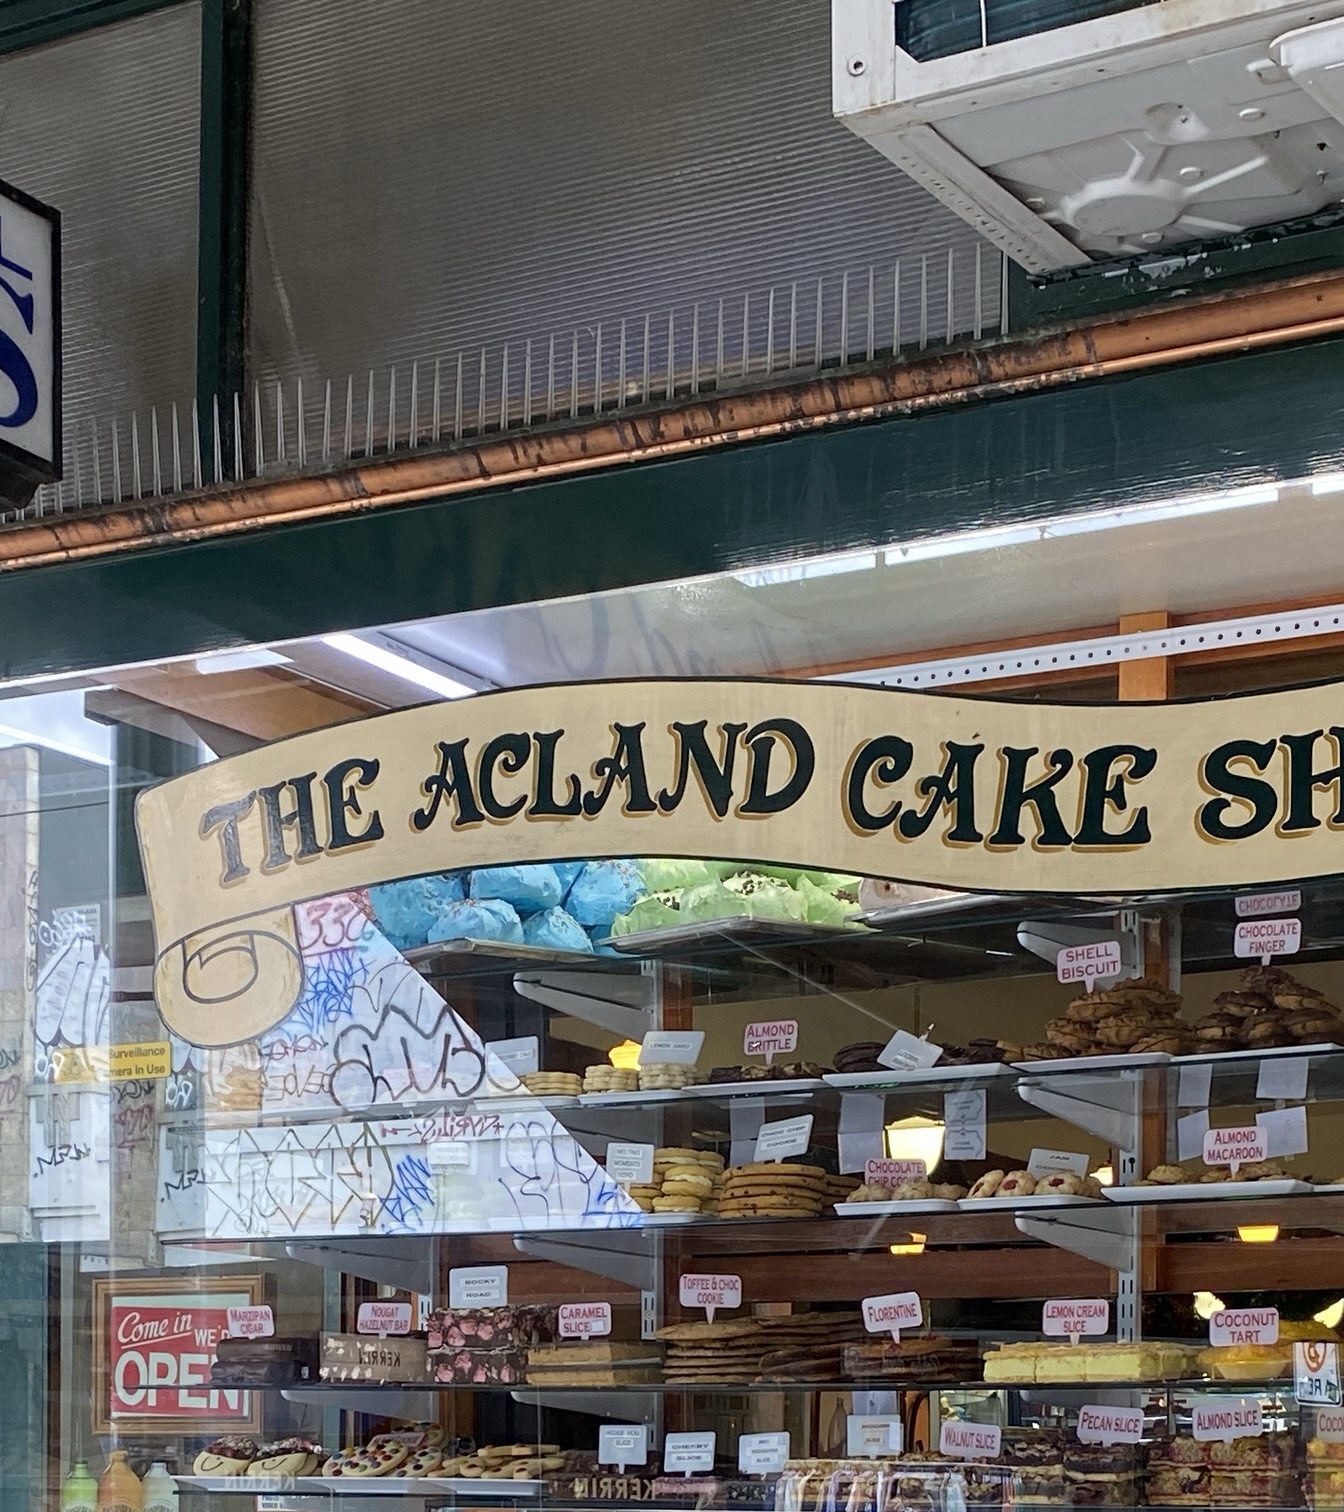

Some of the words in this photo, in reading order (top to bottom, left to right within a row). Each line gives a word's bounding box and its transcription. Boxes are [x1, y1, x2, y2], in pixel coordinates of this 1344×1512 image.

[199, 757, 385, 886] THE
[410, 718, 816, 829] ACLAND
[845, 735, 1157, 850] CAKE
[1237, 922, 1300, 939] CHOCOLATE
[1248, 939, 1286, 954] FINGER
[1065, 945, 1113, 964] SHELL
[1061, 958, 1119, 979] BISCUIT
[746, 1023, 795, 1038] ALMOND
[747, 1038, 792, 1053] BRITTLE
[109, 1047, 167, 1060] Surveillance
[147, 1063, 166, 1075] Use
[1214, 1130, 1257, 1145] ALMOND
[1207, 1145, 1264, 1161] MACAROON
[868, 1160, 924, 1175] CHOCOLATE
[464, 1278, 497, 1286] ROCKY
[682, 1276, 710, 1291] TOFFEE
[719, 1277, 740, 1291] CHOC
[229, 1309, 271, 1322] MARZIPAN
[560, 1306, 608, 1319] CARAMEL
[867, 1303, 917, 1322] FLORENTINE
[1045, 1305, 1074, 1320] LEMON
[1075, 1304, 1106, 1319] CREAM
[117, 1311, 168, 1344] Come
[173, 1311, 193, 1332] in
[563, 1321, 590, 1333] SLICE
[1062, 1319, 1087, 1333] SLICE
[1214, 1313, 1276, 1328] COCONUT
[240, 1323, 265, 1335] CIGAR
[1229, 1329, 1261, 1344] TART
[1081, 1412, 1113, 1432] PECAN
[1114, 1417, 1140, 1434] SLICE
[1197, 1412, 1232, 1431] ALMOND
[1233, 1408, 1258, 1426] SLICE
[944, 1430, 975, 1448] WALNUT
[976, 1434, 996, 1450] SLICE
